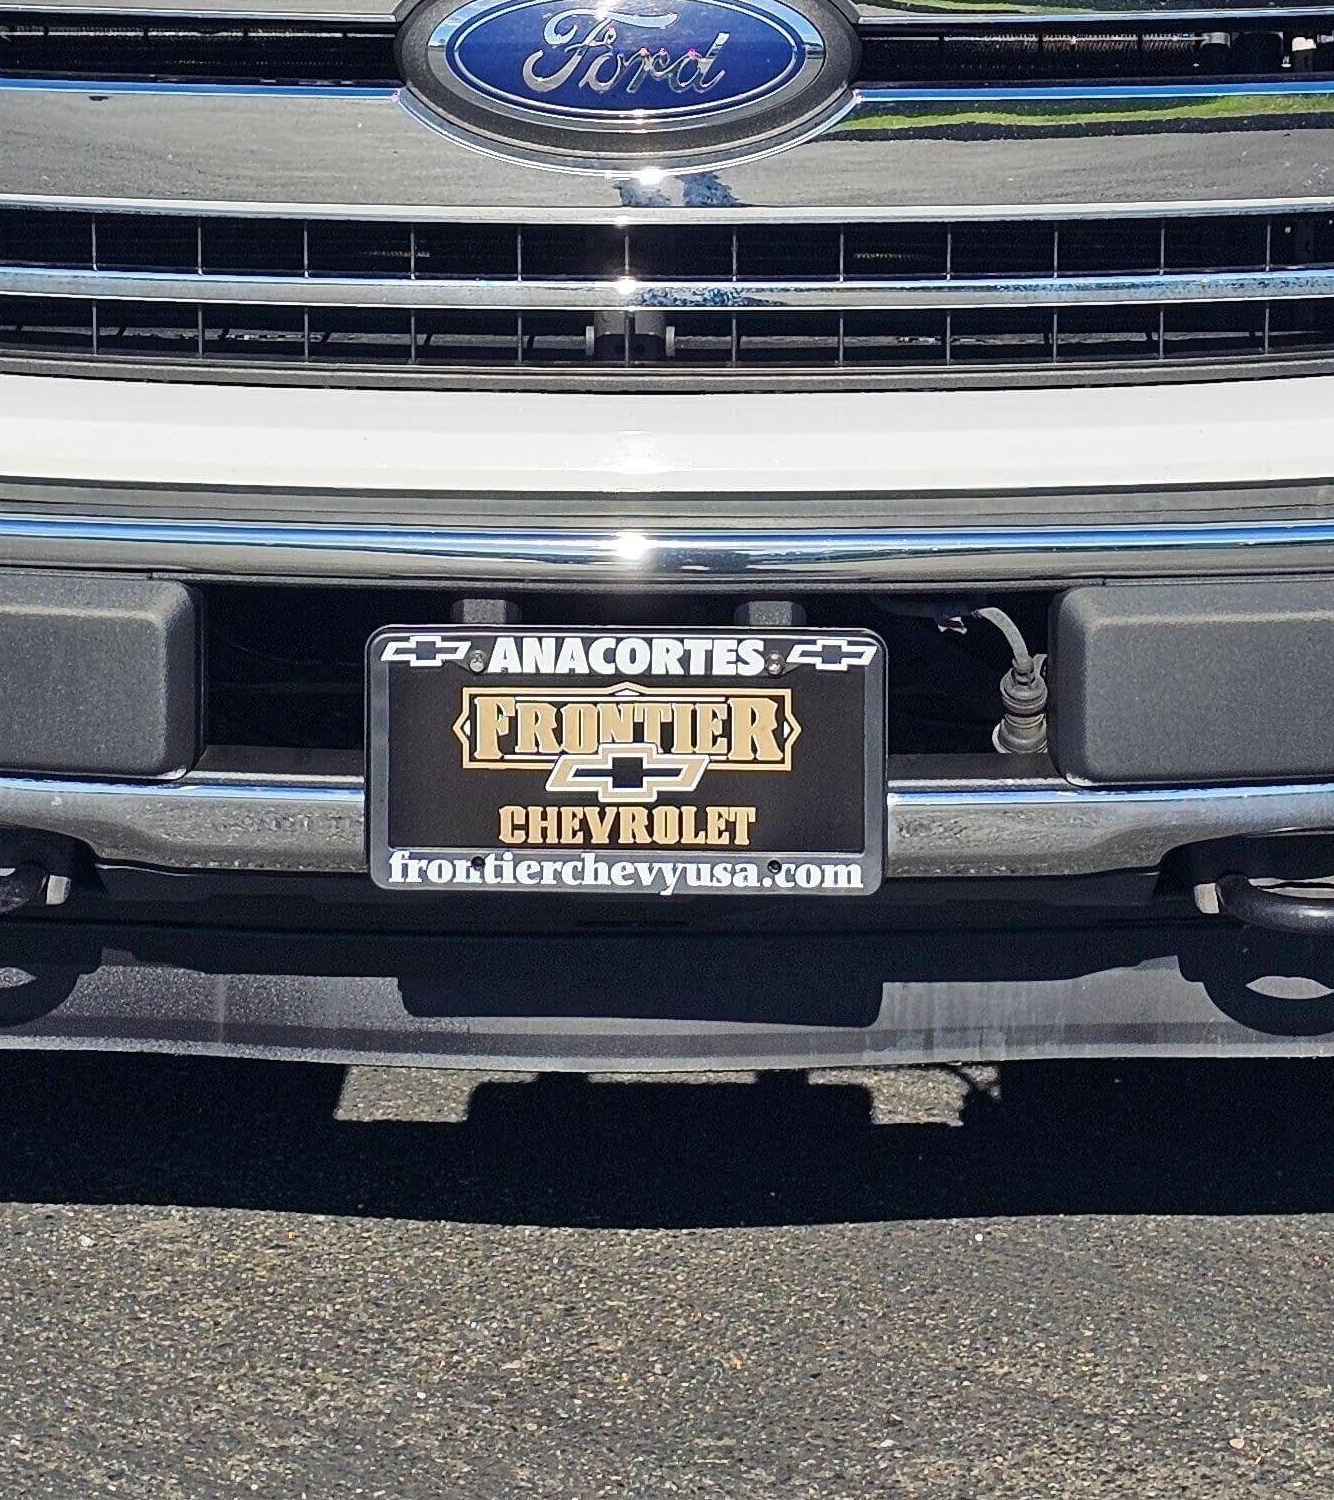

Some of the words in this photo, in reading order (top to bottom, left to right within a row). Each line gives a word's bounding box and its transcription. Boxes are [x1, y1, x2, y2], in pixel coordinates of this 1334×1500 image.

[521, 7, 731, 94] Ford
[486, 635, 766, 676] ANACORTES
[472, 695, 784, 762] FRONTIER
[497, 805, 757, 845] CHEVROLET
[387, 849, 865, 896] frontierchevyusa.com
